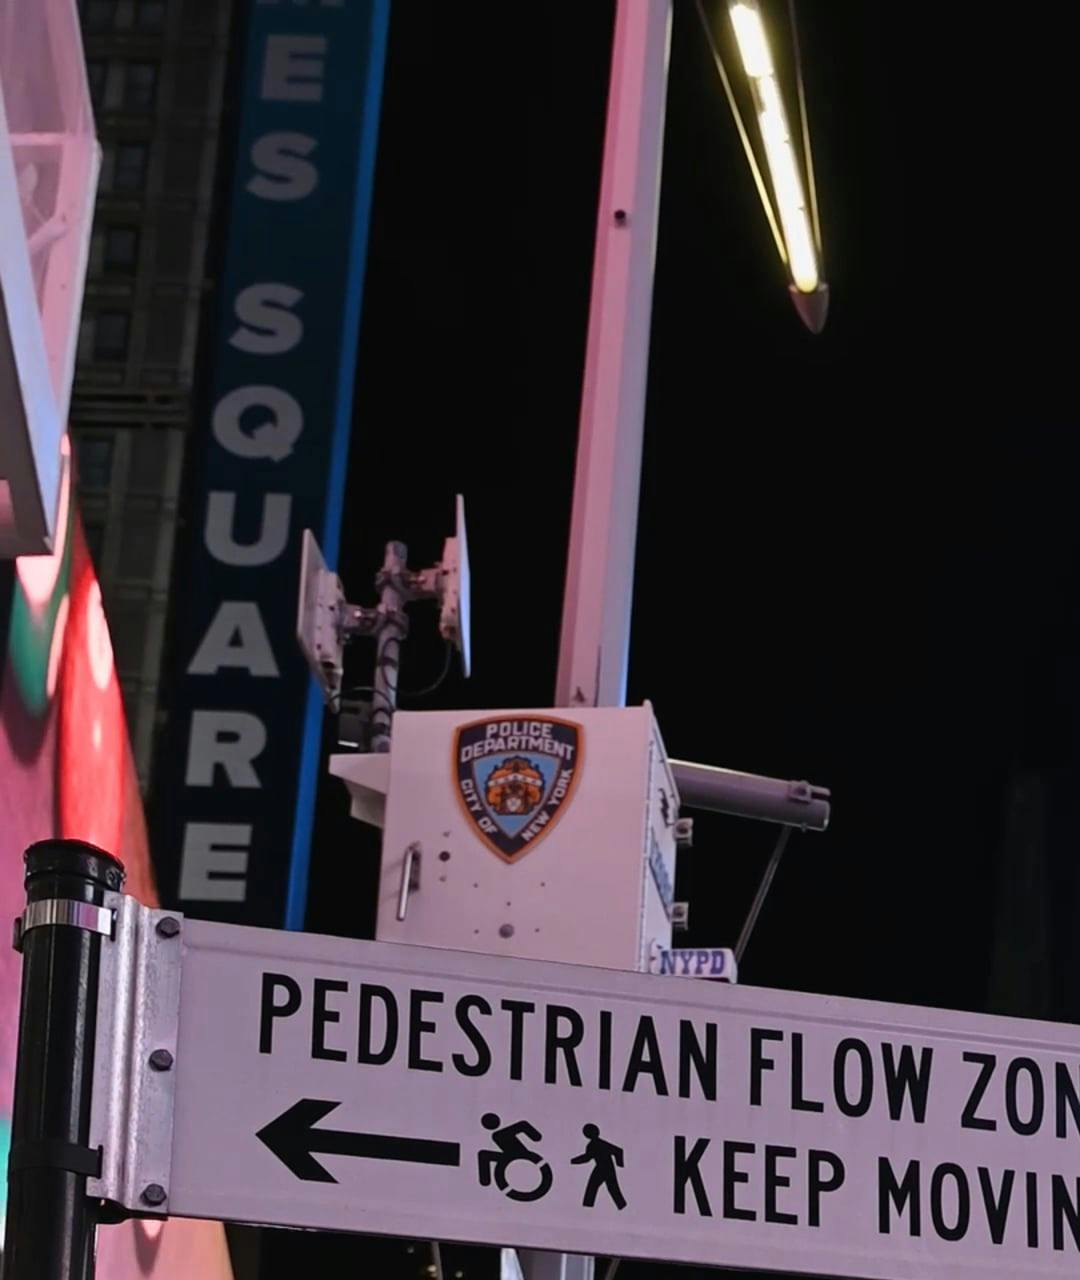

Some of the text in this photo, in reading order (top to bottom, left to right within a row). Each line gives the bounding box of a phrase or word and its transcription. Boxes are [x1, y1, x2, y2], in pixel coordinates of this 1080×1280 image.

[170, 0, 345, 902] ES SQUARE
[461, 736, 574, 762] DEPARTMENT
[486, 721, 554, 738] POLICE
[461, 779, 498, 833] CITY OF
[521, 769, 573, 841] NEW YORK
[660, 950, 726, 975] NYPD
[258, 972, 718, 1102] PEDESTRIAN
[749, 1027, 933, 1124] FLOW
[673, 1135, 845, 1228] KEEP
